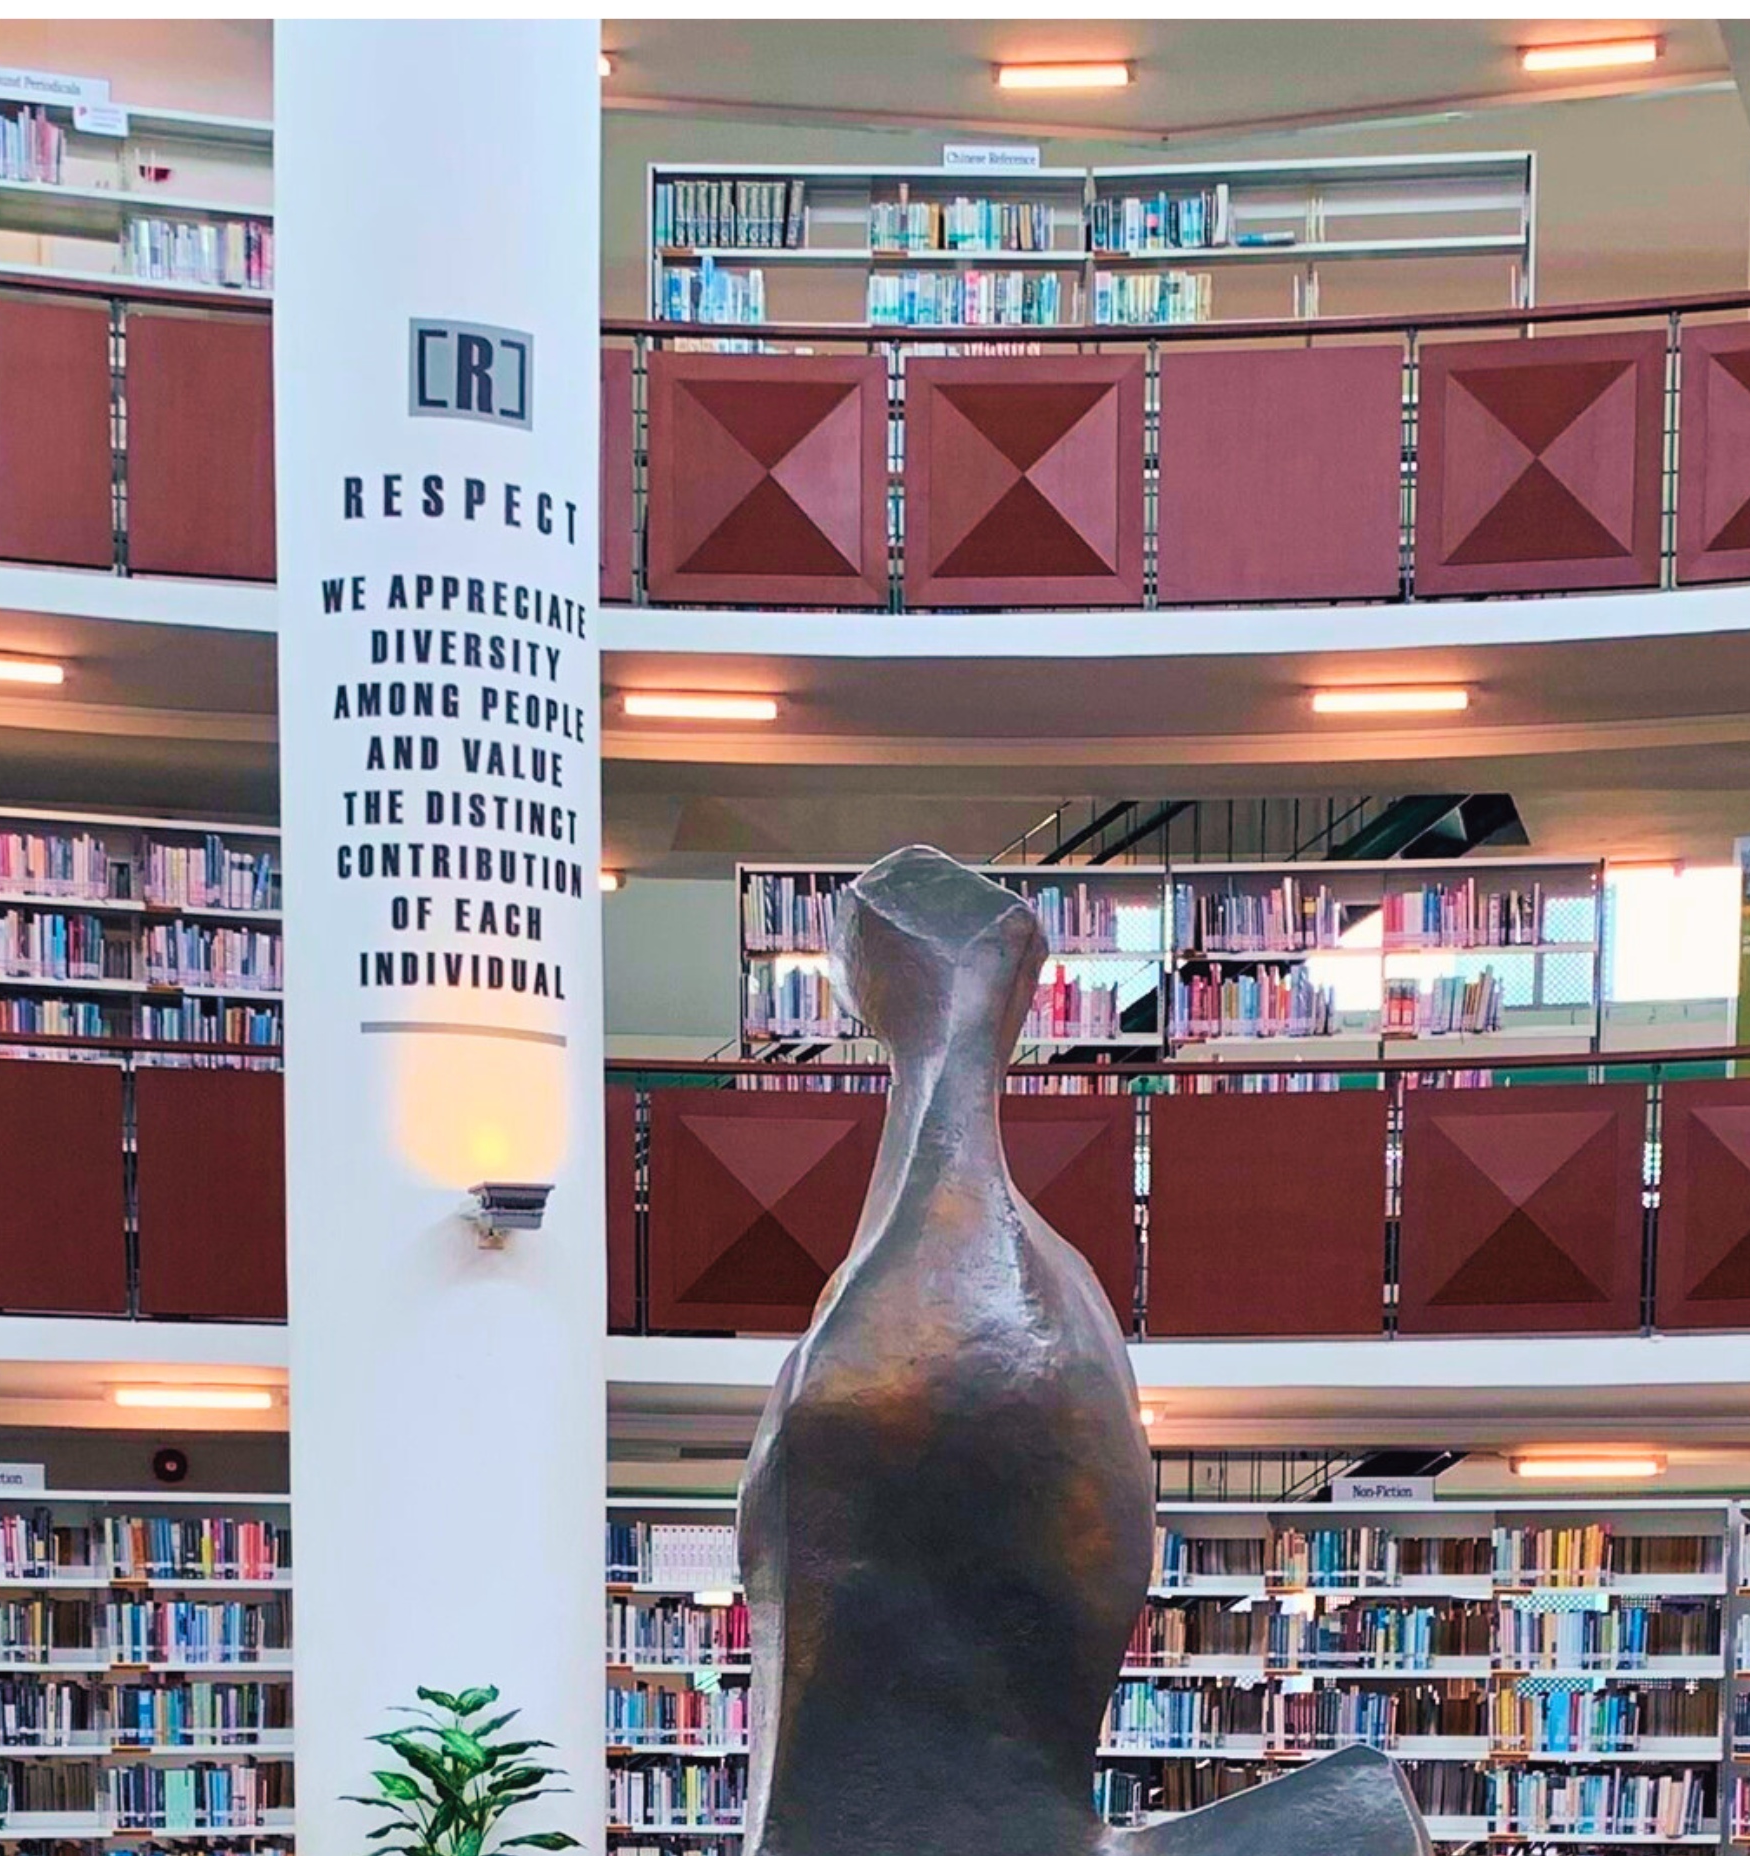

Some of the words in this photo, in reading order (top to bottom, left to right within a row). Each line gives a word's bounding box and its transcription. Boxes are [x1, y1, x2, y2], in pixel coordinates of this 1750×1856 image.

[344, 474, 577, 545] RESPECT
[322, 576, 366, 614] WE
[388, 574, 585, 640] APPRECIATE
[371, 629, 561, 682] DIVERSITY
[334, 682, 460, 720] AMONG
[481, 686, 584, 744] PEOPLE
[366, 735, 439, 771] AND
[462, 737, 563, 788] VALUE
[343, 789, 404, 826] THE
[426, 790, 577, 845] DISTINCT
[337, 843, 582, 900] CONTRIBUTION
[392, 896, 432, 931] OF
[455, 898, 542, 941] EACH
[360, 952, 565, 1000] INDIVIDUAL
[1353, 1485, 1413, 1498] Non-Fiction
